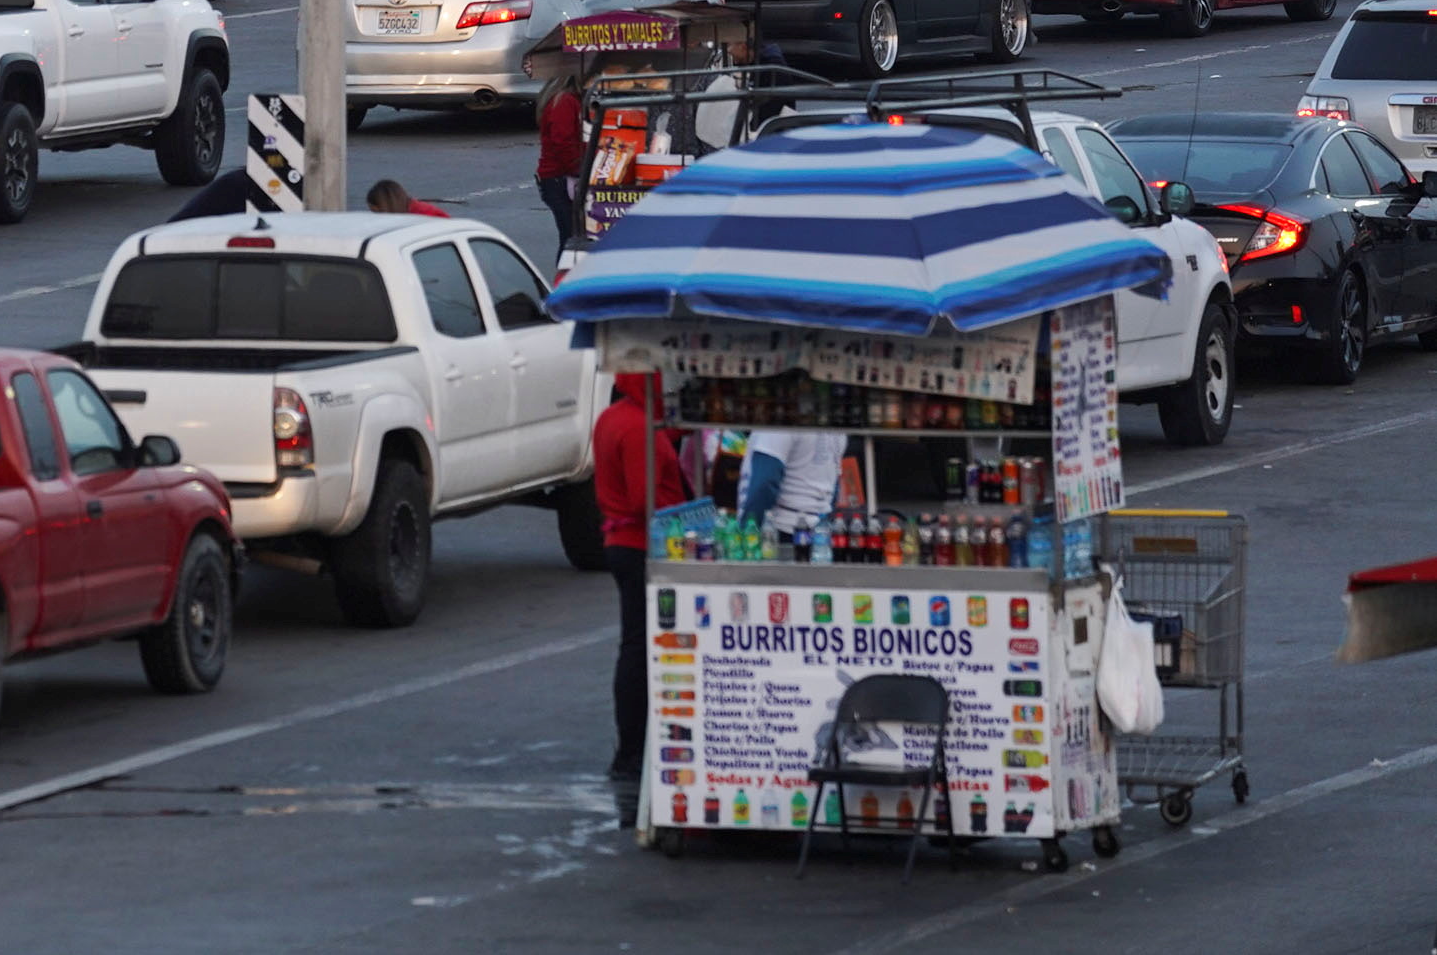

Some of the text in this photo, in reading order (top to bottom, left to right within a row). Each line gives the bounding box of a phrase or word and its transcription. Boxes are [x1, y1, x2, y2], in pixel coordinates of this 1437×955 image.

[564, 22, 663, 46] BURRITOS Y TAMALES
[573, 42, 658, 52] YANETH
[720, 625, 973, 656] BURRITOS BIONICOS
[802, 655, 893, 667] EL NETO
